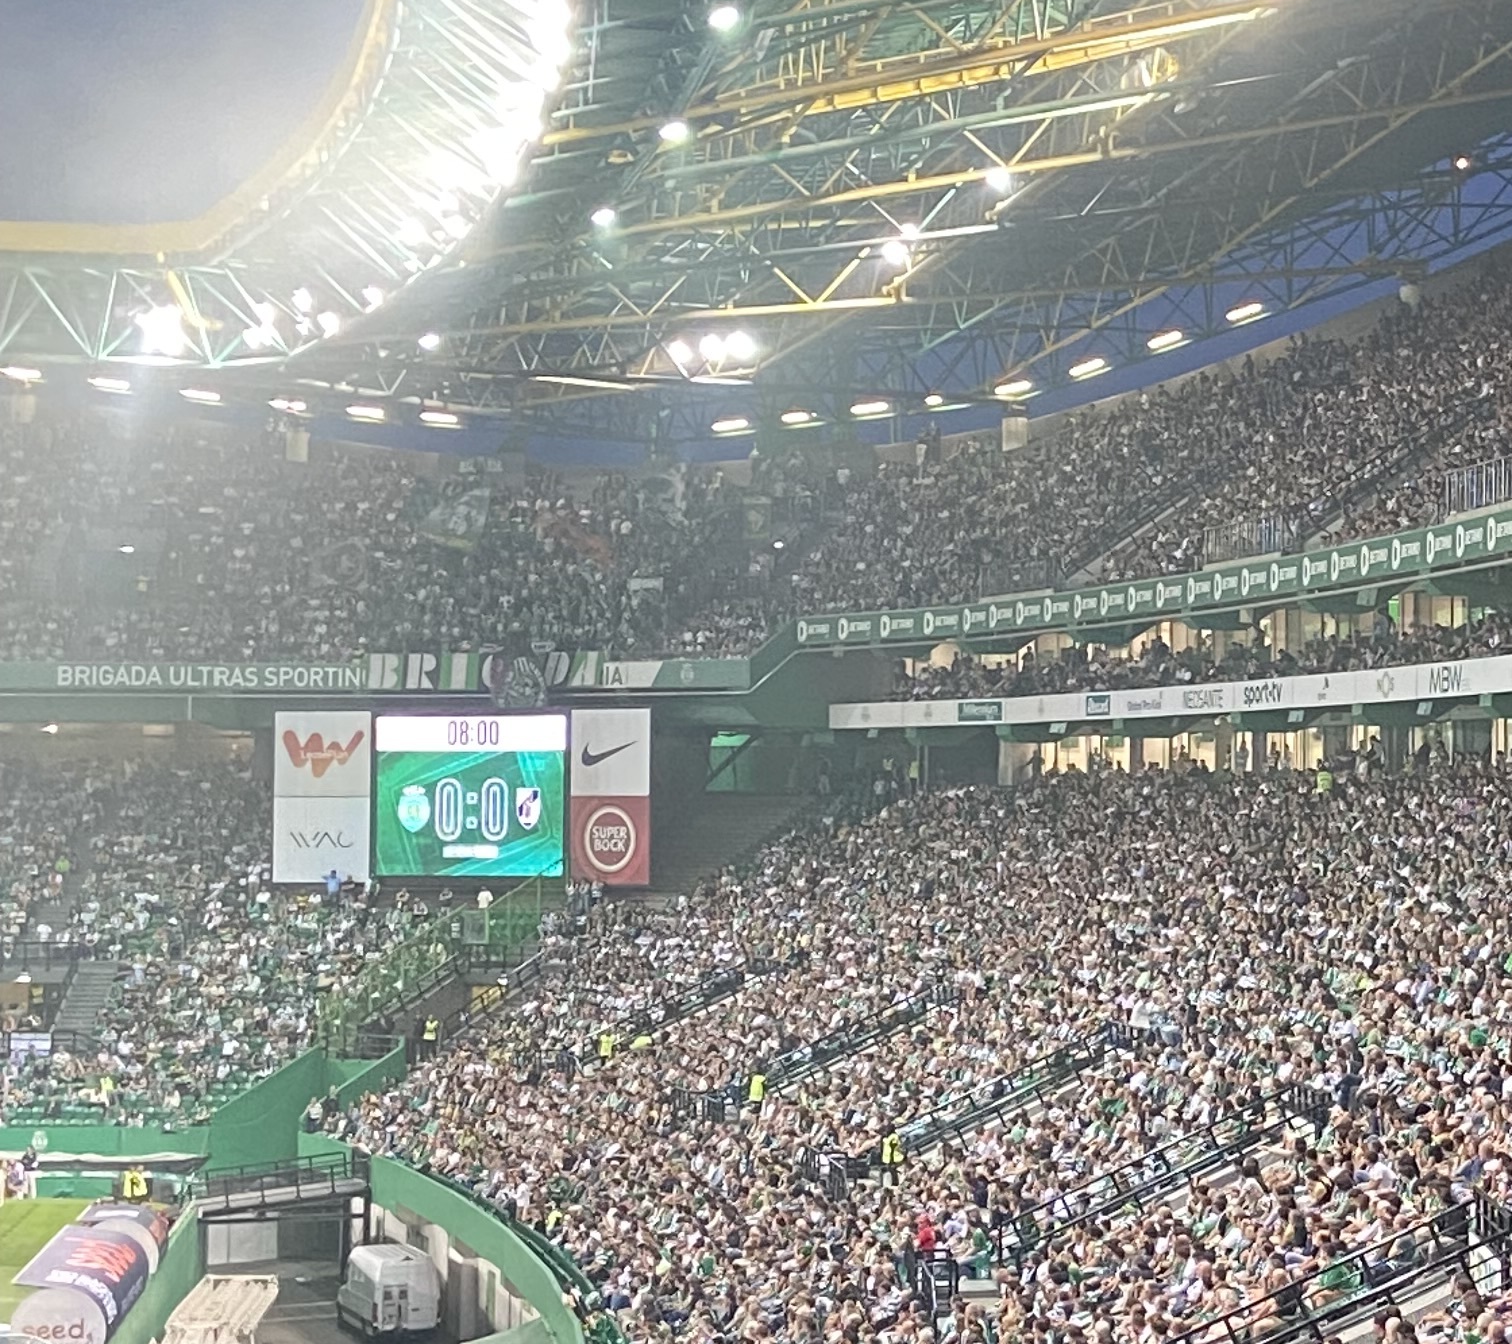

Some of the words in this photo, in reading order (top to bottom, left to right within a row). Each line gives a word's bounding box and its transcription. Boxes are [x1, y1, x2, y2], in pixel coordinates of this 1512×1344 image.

[57, 665, 162, 687] BRIGADA
[169, 665, 258, 687] ULTRAS
[368, 652, 600, 689] BRIDA
[1429, 664, 1463, 694] MBW
[447, 720, 499, 746] 08:00
[592, 826, 628, 840] SUPER
[594, 839, 626, 852] BOCK
